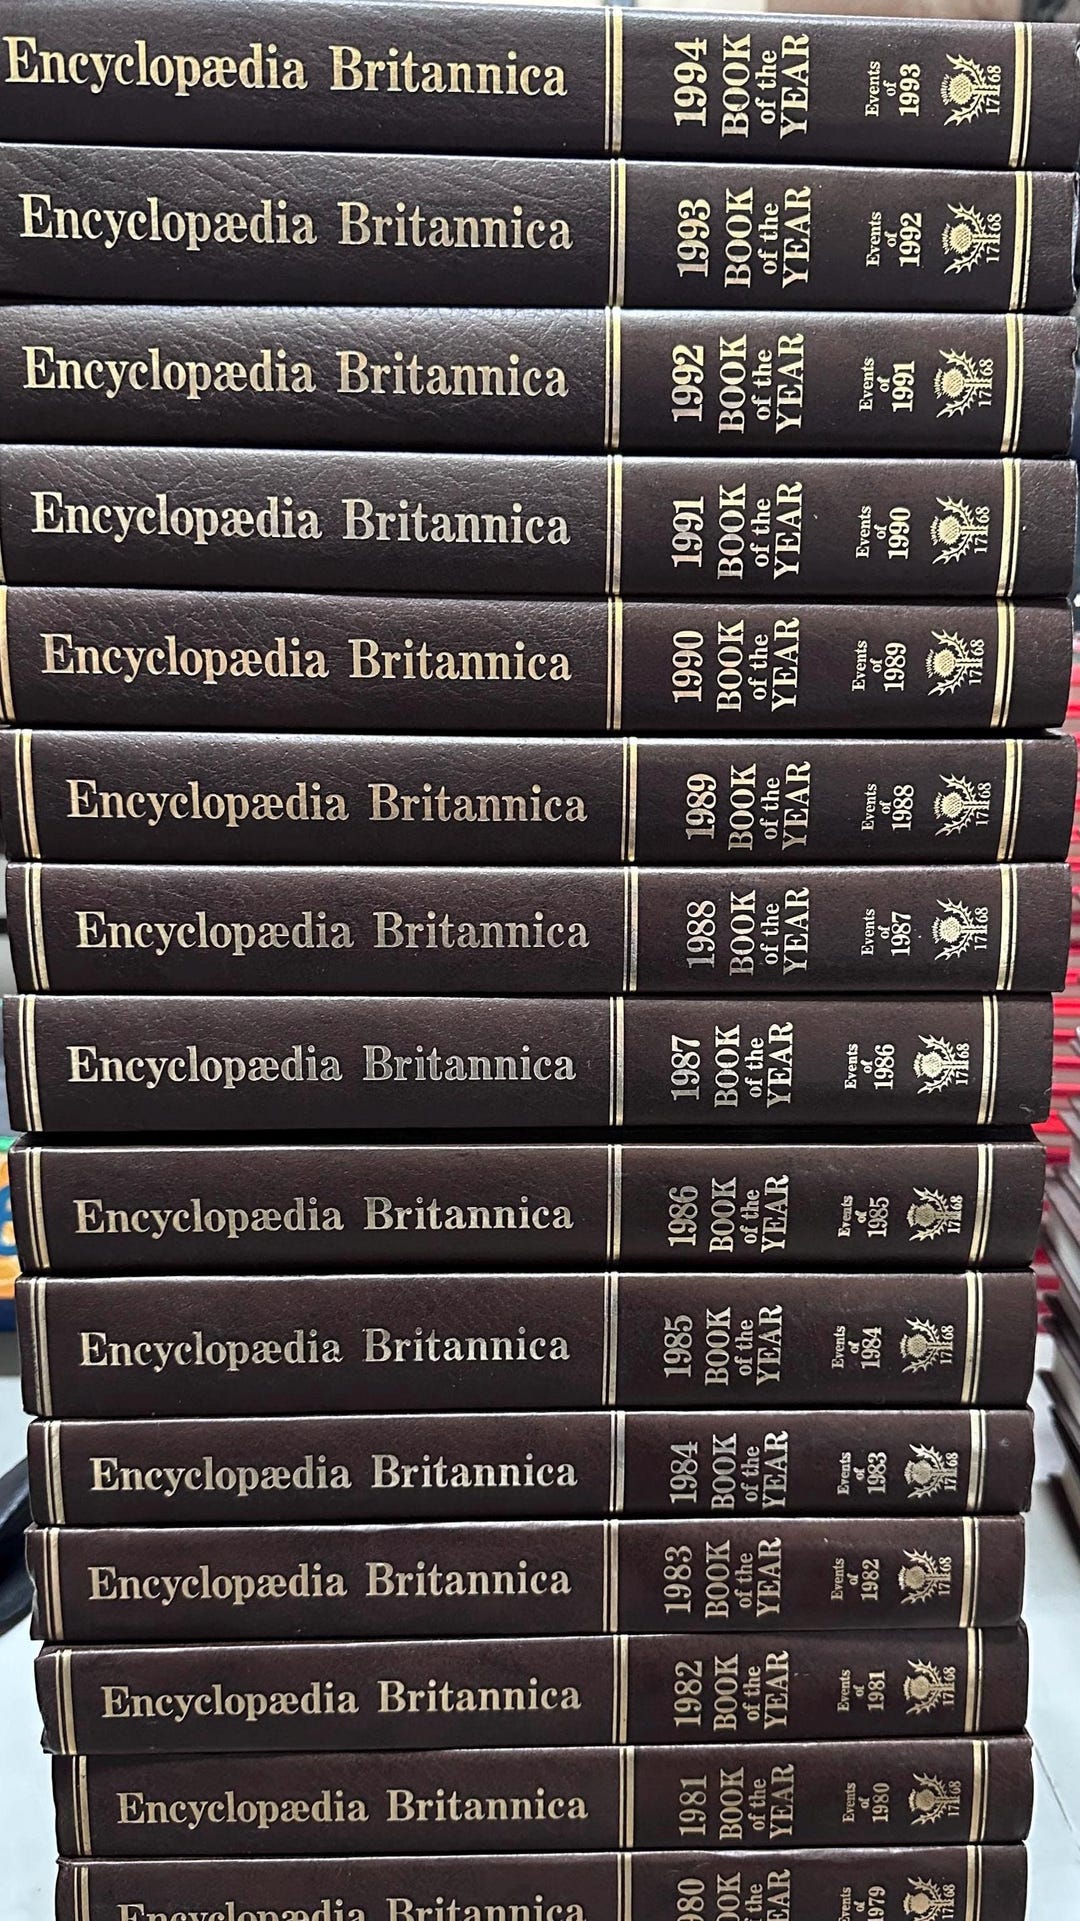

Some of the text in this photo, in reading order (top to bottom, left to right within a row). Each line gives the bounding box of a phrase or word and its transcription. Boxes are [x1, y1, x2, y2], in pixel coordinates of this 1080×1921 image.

[2, 36, 568, 96] Encyclopædia Britannica
[674, 37, 707, 126] 1994
[722, 33, 751, 138] BOOK
[755, 50, 777, 124] of the
[780, 33, 809, 139] YEAR
[865, 61, 880, 117] Events
[885, 80, 897, 97] of
[898, 64, 921, 117] 1993
[18, 192, 574, 251] Encyclopædia Britannica
[677, 199, 711, 277] 1993
[724, 187, 753, 288] BOOK
[757, 203, 779, 275] of the
[782, 185, 811, 288] YEAR
[866, 211, 882, 267] Events
[885, 231, 897, 248] of
[899, 212, 922, 267] 1992
[21, 344, 569, 400] Encyclopædia Britannica
[671, 344, 704, 422] 1992
[718, 333, 747, 434] BOOK
[751, 349, 772, 420] of the
[776, 333, 804, 434] YEAR
[859, 356, 874, 411] Events
[878, 376, 890, 392] of
[892, 360, 915, 412] 1991
[30, 489, 571, 545] Encyclopædia Britannica
[671, 496, 704, 567] 1991
[717, 483, 746, 579] BOOK
[750, 498, 771, 567] of the
[774, 481, 803, 580] YEAR
[856, 506, 872, 558] Events
[875, 524, 887, 540] of
[888, 507, 911, 559] 1990
[39, 630, 572, 685] Encyclopædia Britannica
[672, 630, 704, 703] 1990
[716, 619, 744, 712] BOOK
[747, 634, 769, 700] of the
[771, 617, 800, 712] YEAR
[852, 640, 867, 691] Events
[871, 658, 883, 673] of
[883, 642, 906, 692] 1989
[65, 779, 588, 827] Encyclopædia Britannica
[686, 773, 717, 840] 1989
[728, 763, 756, 850] BOOK
[759, 777, 780, 840] of the
[782, 761, 811, 850] YEAR
[861, 784, 877, 831] Events
[877, 800, 891, 814] of
[891, 785, 914, 831] 1988
[74, 911, 590, 956] Encyclopædia Britannica
[686, 900, 716, 968] 1988
[729, 889, 756, 976] BOOK
[760, 903, 780, 965] of the
[783, 887, 809, 975] YEAR
[861, 909, 875, 955] Events
[878, 925, 890, 939] of
[891, 911, 911, 956] 1987
[66, 1041, 576, 1089] Encyclopædia Britannica
[671, 1035, 700, 1101] 1987
[714, 1024, 740, 1107] BOOK
[744, 1038, 764, 1098] of the
[767, 1022, 793, 1108] YEAR
[844, 1043, 858, 1089] Events
[861, 1060, 873, 1074] of
[874, 1044, 895, 1090] 1986
[73, 1196, 574, 1239] Encyclopædia Britannica
[667, 1186, 698, 1247] 1986
[709, 1177, 736, 1253] BOOK
[739, 1189, 760, 1244] of the
[761, 1174, 789, 1253] YEAR
[838, 1195, 853, 1237] Events
[852, 1210, 867, 1223] of
[867, 1197, 889, 1238] 1985
[79, 1326, 570, 1373] Encyclopædia Britannica
[663, 1315, 693, 1378] 1985
[705, 1307, 731, 1386] BOOK
[734, 1320, 754, 1376] of the
[756, 1304, 783, 1385] YEAR
[831, 1326, 846, 1369] Events
[846, 1341, 860, 1354] of
[861, 1327, 882, 1369] 1984
[89, 1453, 578, 1497] Encyclopædia Britannica
[669, 1441, 698, 1504] 1984
[711, 1432, 737, 1509] BOOK
[741, 1446, 760, 1502] of the
[762, 1430, 789, 1508] YEAR
[837, 1452, 851, 1495] Events
[854, 1467, 865, 1481] of
[867, 1452, 887, 1494] 1983
[87, 1560, 572, 1606] Encyclopædia Britannica
[663, 1546, 692, 1614] 1983
[705, 1539, 730, 1618] BOOK
[734, 1553, 753, 1608] of the
[756, 1537, 782, 1617] YEAR
[831, 1558, 845, 1600] Events
[847, 1573, 859, 1586] of
[860, 1559, 879, 1601] 1982
[100, 1677, 581, 1722] Encyclopædia Britannica
[673, 1661, 702, 1727] 1982
[713, 1653, 738, 1731] BOOK
[742, 1666, 761, 1721] of the
[764, 1650, 789, 1730] YEAR
[837, 1669, 851, 1711] Events
[854, 1684, 865, 1697] of
[867, 1670, 885, 1711] 1981
[116, 1787, 588, 1830] Encyclopædia Britannica
[679, 1775, 707, 1836] 1981
[719, 1766, 744, 1840] BOOK
[747, 1779, 766, 1831] of the
[769, 1764, 794, 1840] YEAR
[842, 1782, 856, 1823] Events
[859, 1797, 870, 1809] of
[872, 1783, 890, 1822] 1980
[386, 1895, 583, 1921] Britannica
[744, 1884, 763, 1913] the
[767, 1869, 790, 1921] EAR
[854, 1901, 865, 1912] of
